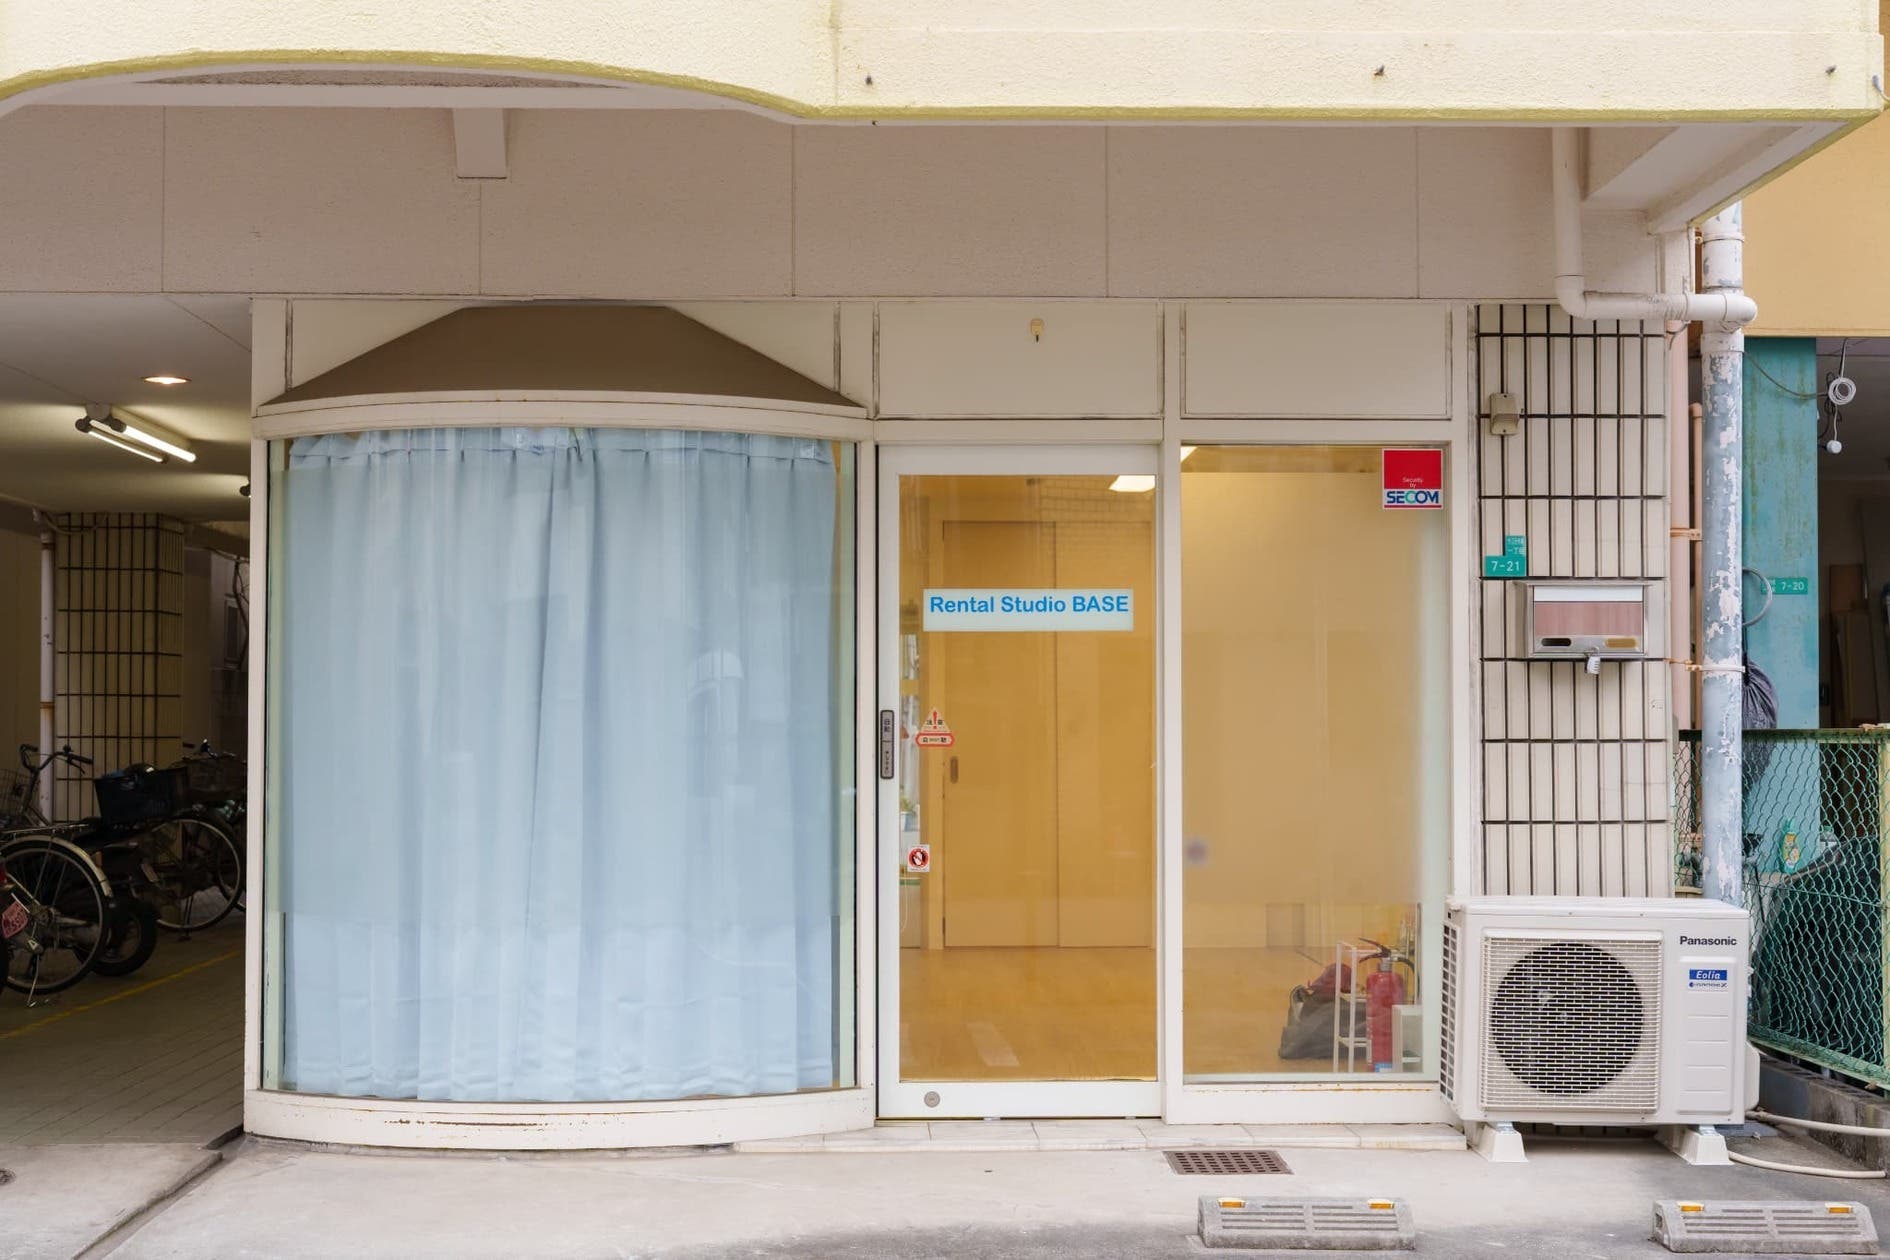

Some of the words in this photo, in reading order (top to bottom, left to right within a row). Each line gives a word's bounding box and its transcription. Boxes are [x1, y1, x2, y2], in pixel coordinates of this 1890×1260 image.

[1386, 490, 1439, 504] SECOM
[1491, 560, 1519, 573] 7-21
[1781, 580, 1805, 591] 7-20
[930, 596, 995, 613] Rental
[1000, 596, 1067, 613] Studio
[1072, 596, 1129, 613] BASE
[1679, 935, 1738, 946] Panasonic
[1696, 970, 1721, 979] Eolia
